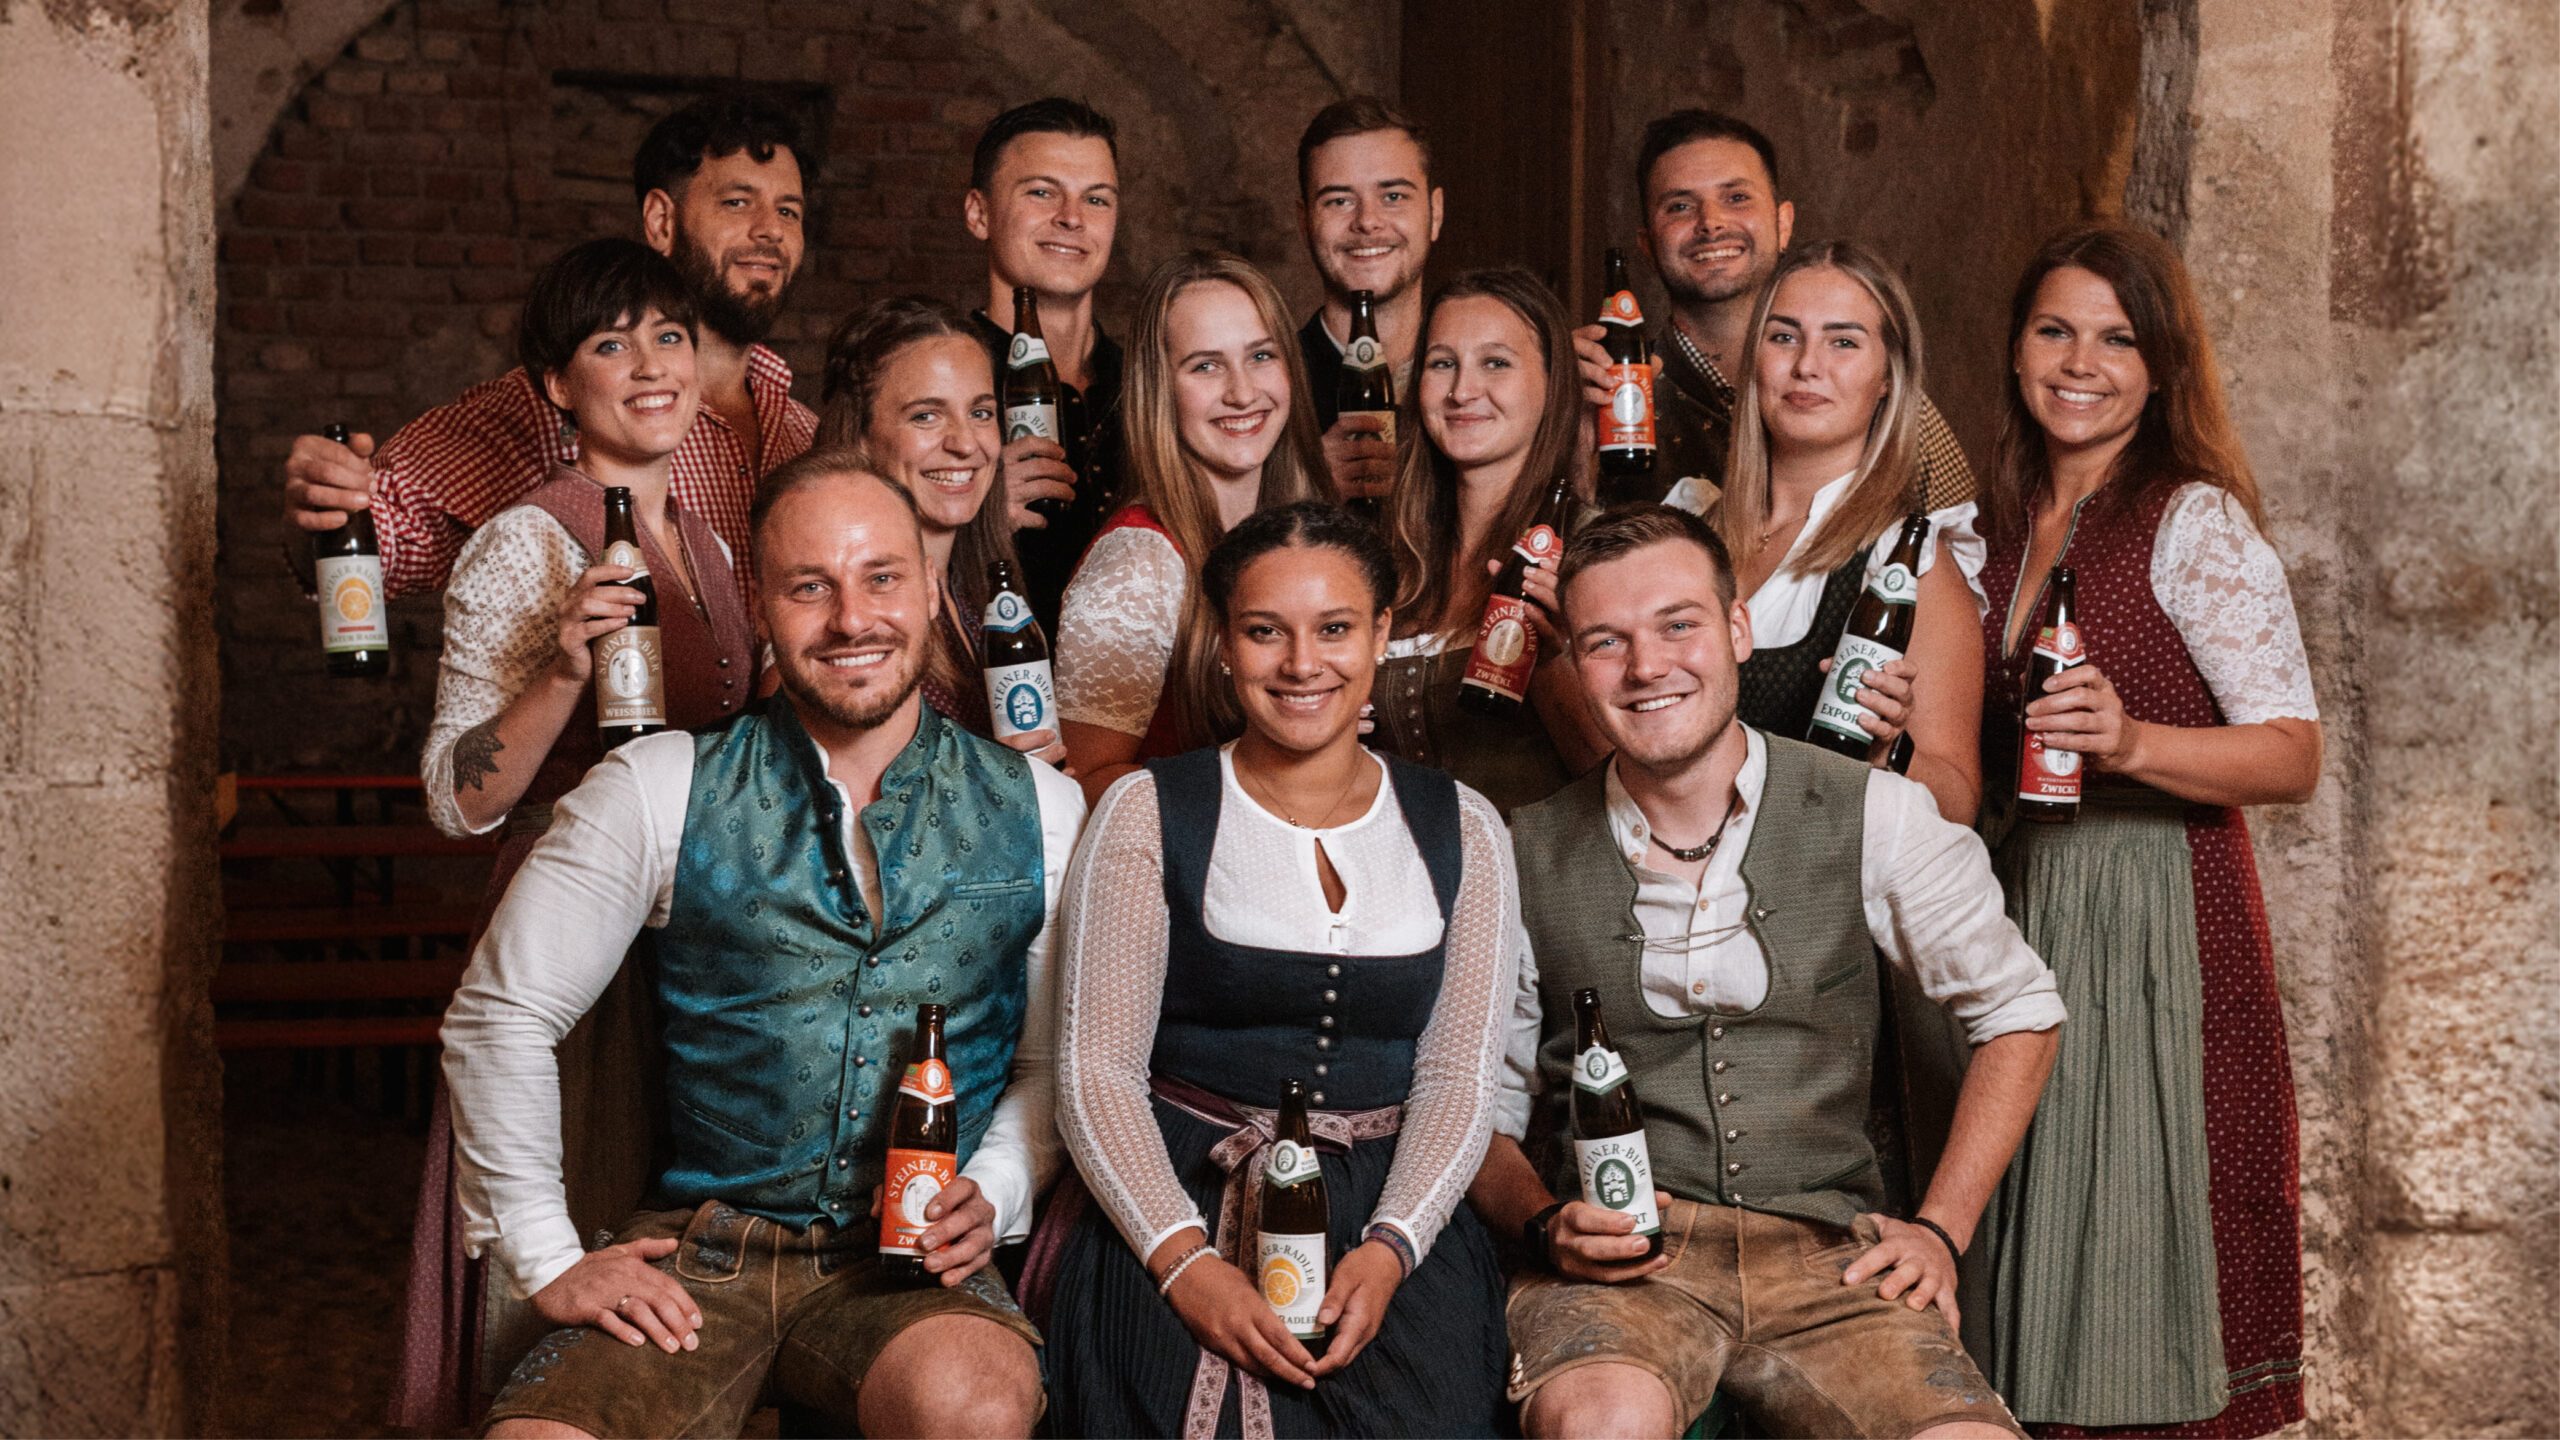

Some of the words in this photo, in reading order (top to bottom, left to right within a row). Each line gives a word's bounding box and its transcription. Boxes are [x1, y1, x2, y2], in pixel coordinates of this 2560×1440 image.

[994, 669, 1053, 711] STEINER-BIER
[604, 706, 658, 718] WEISSBIER
[888, 1159, 952, 1199] STEINER-BI
[1584, 1143, 1647, 1187] STEINER-BIER
